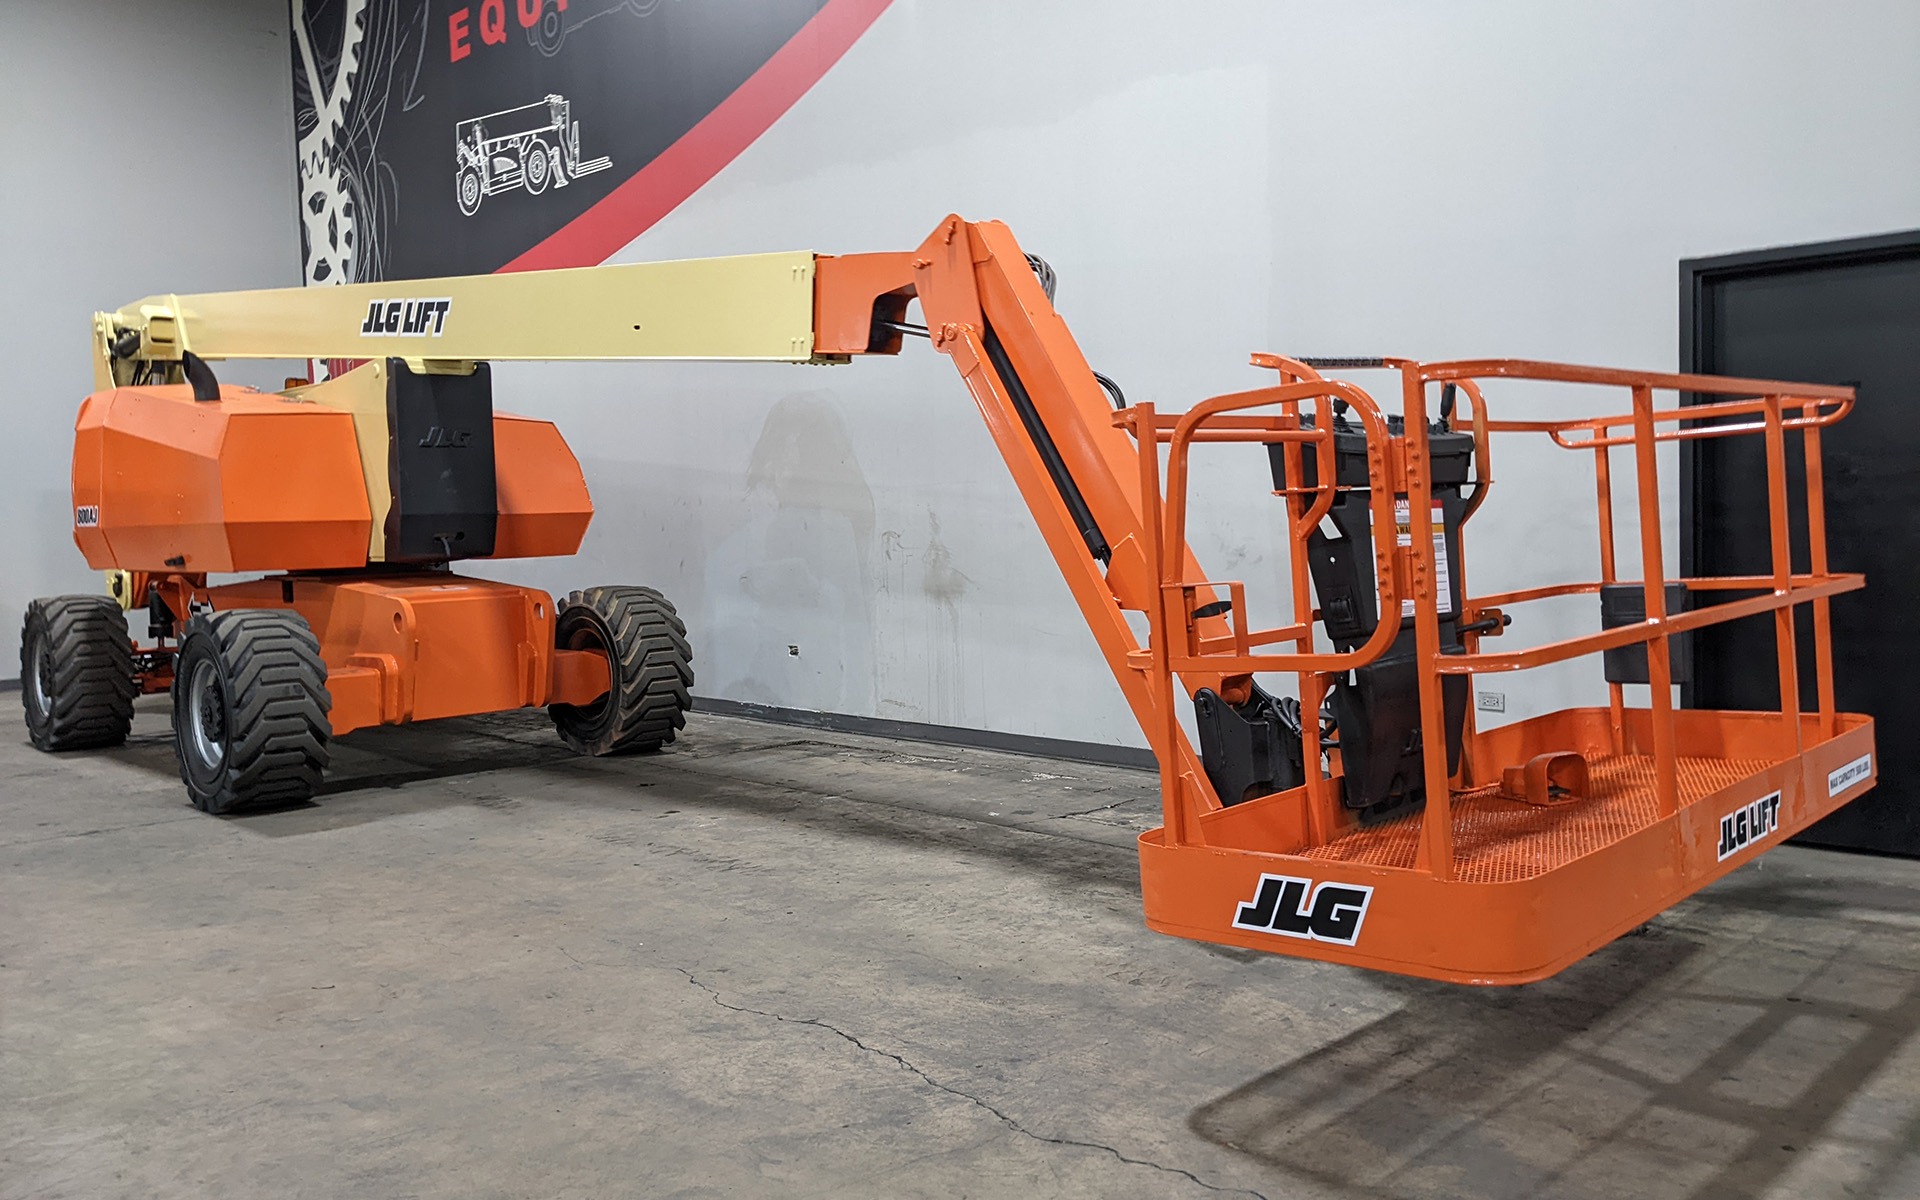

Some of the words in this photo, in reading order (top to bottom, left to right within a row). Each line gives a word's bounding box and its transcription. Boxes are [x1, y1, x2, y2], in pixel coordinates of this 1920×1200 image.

[448, 0, 569, 64] EQU
[361, 300, 404, 334] JLG
[401, 299, 451, 334] LIFT
[418, 425, 472, 449] JLG
[1718, 809, 1748, 858] JLG
[1749, 793, 1781, 841] LIFT
[1235, 875, 1371, 943] JLG
